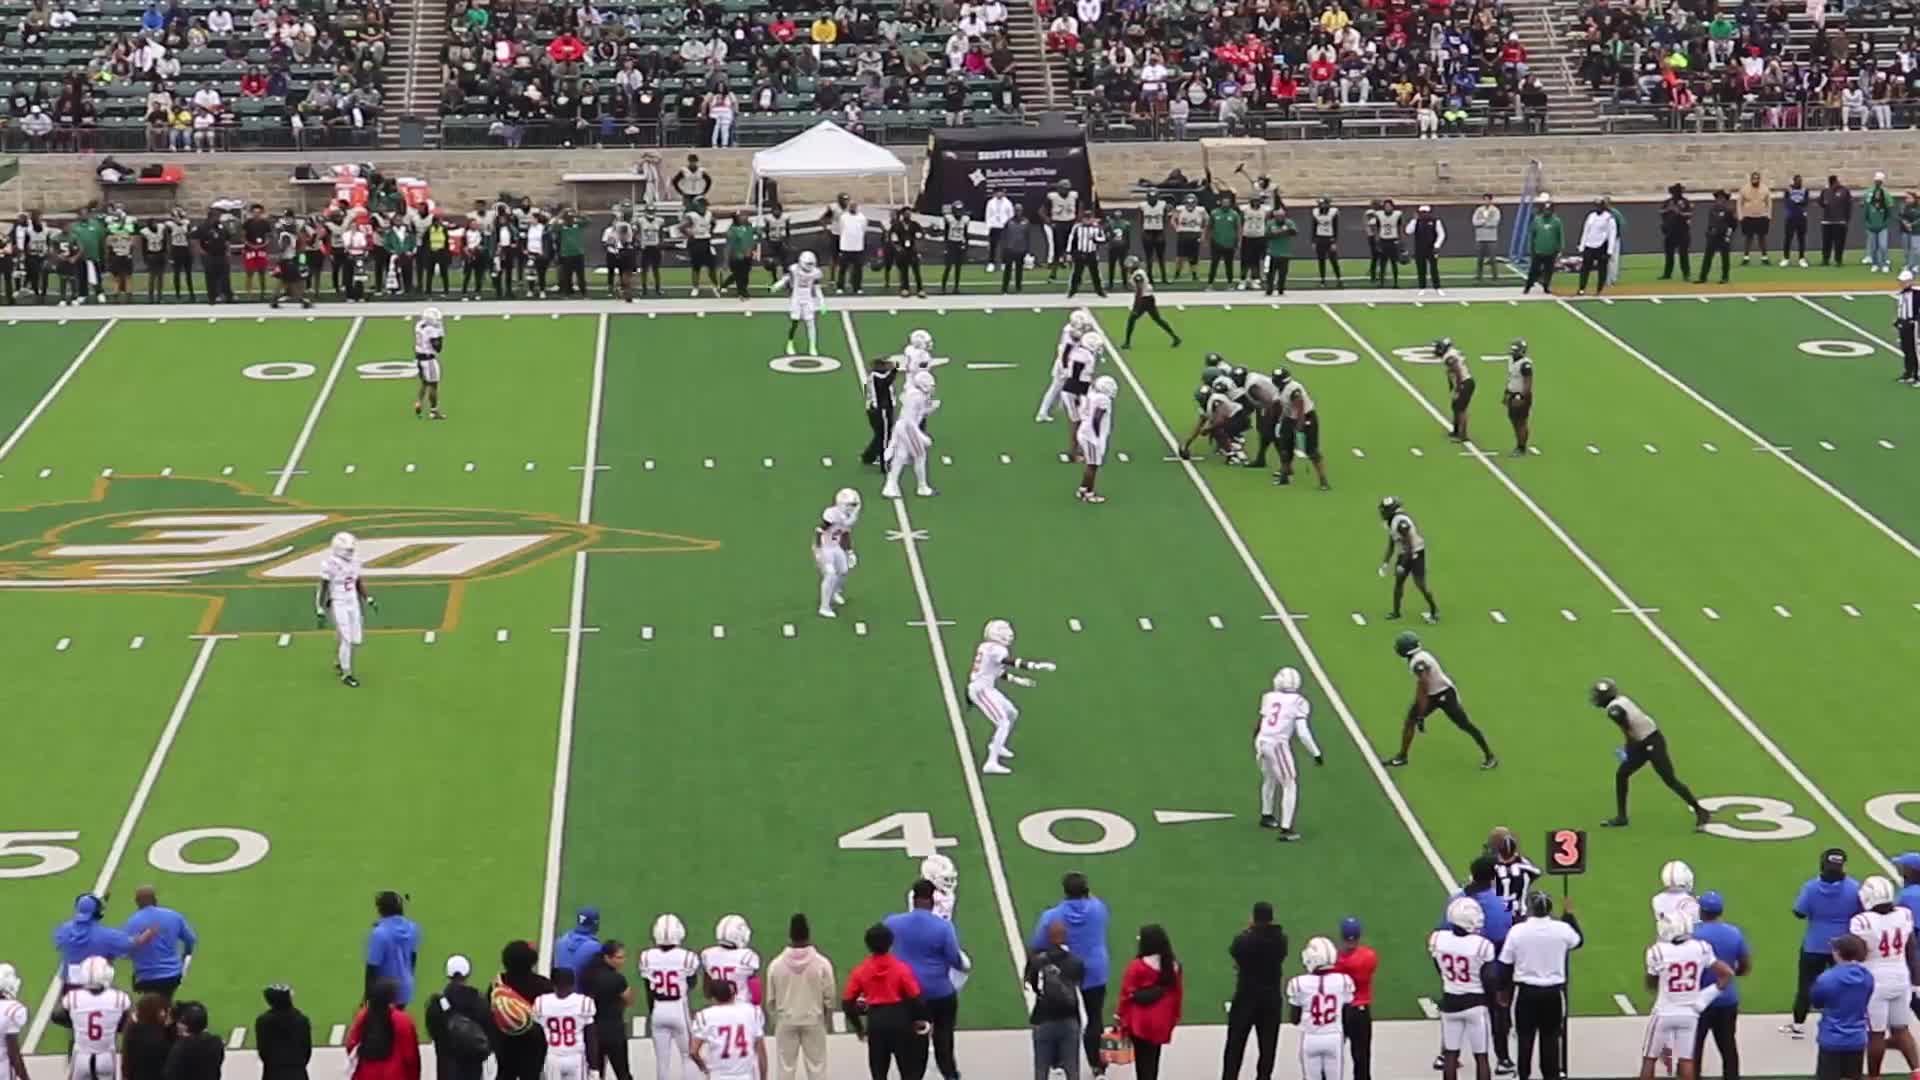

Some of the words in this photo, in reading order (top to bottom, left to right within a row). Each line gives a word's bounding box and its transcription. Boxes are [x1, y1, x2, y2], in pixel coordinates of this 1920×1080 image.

[60, 242, 70, 256] 5
[1267, 703, 1283, 727] 3
[1554, 830, 1579, 866] 3
[1878, 927, 1904, 959] 44
[1441, 953, 1472, 984] 33
[1667, 961, 1699, 993] 23
[653, 971, 681, 1000] 26
[1310, 994, 1338, 1027] 42
[86, 1012, 103, 1041] 6
[546, 1016, 576, 1047] 88
[717, 1024, 748, 1059] 74
